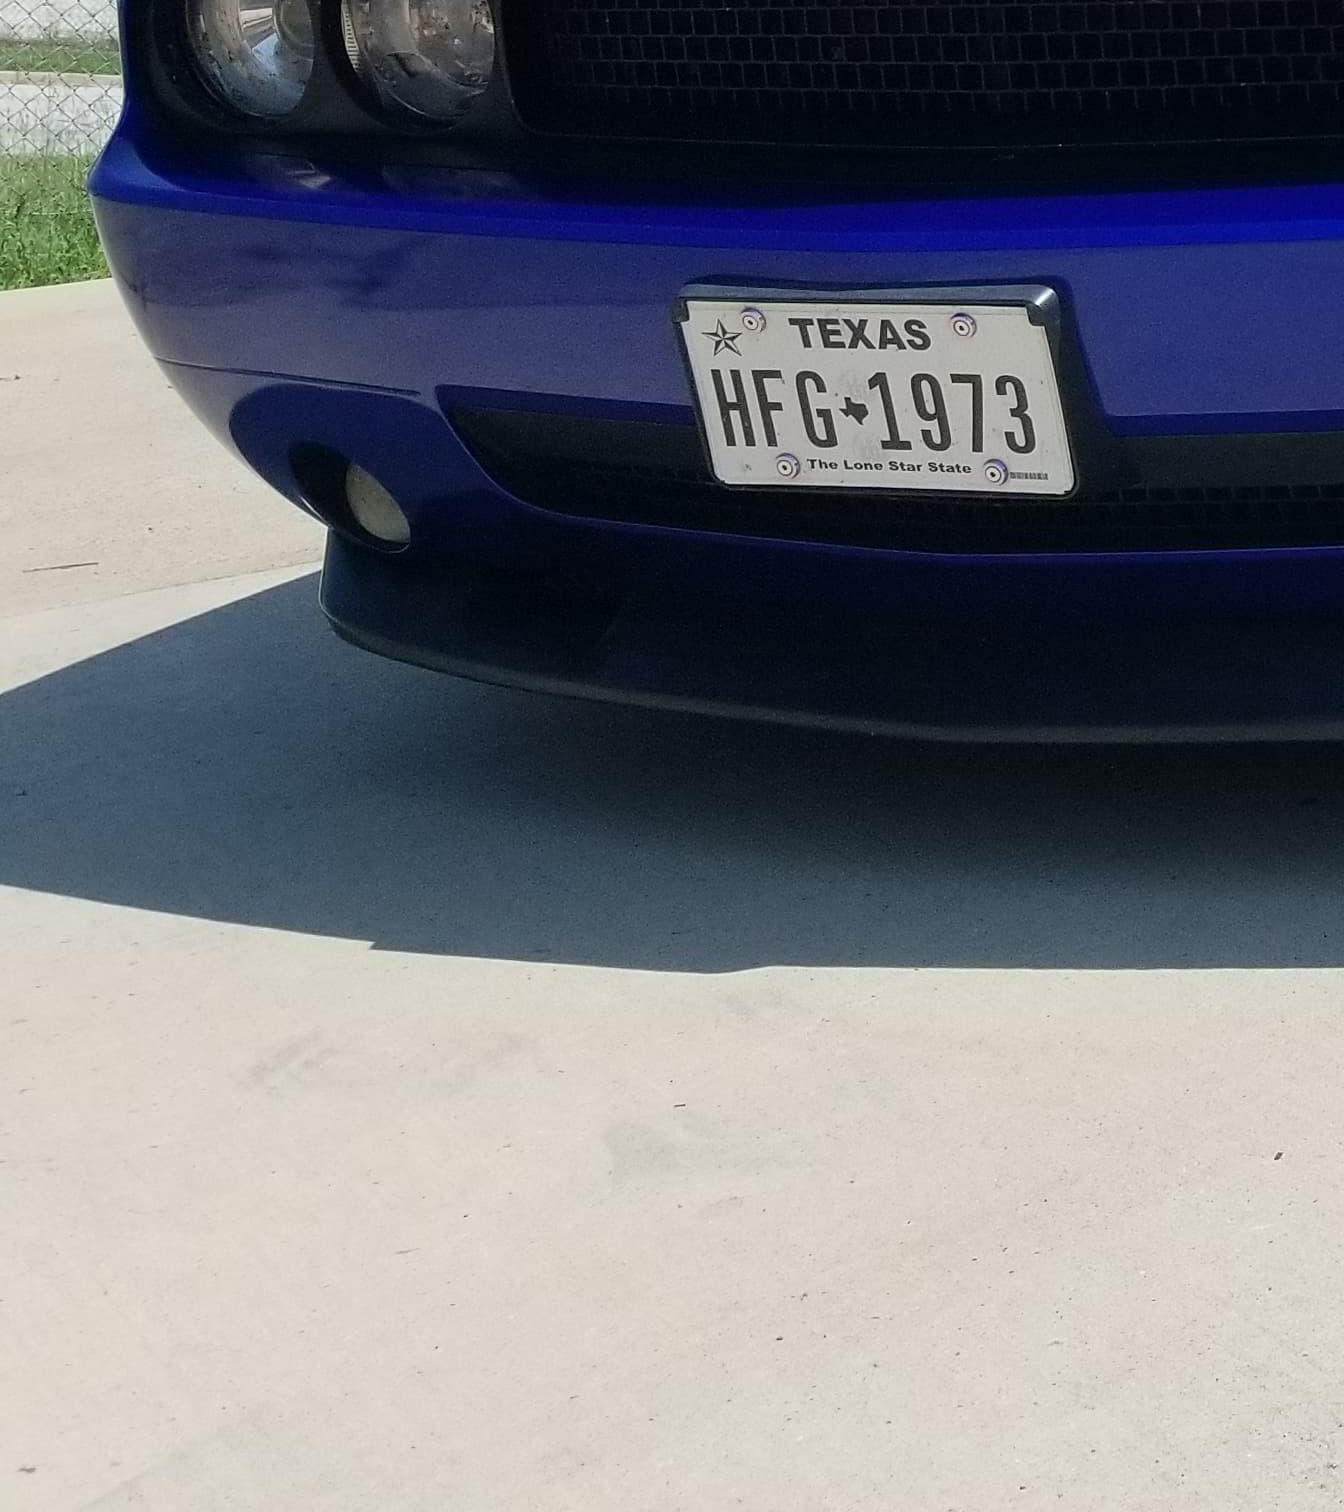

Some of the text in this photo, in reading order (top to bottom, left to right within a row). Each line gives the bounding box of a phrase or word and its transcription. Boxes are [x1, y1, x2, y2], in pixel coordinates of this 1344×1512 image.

[788, 317, 932, 351] TEXAS
[807, 458, 972, 474] The Lone Star State
